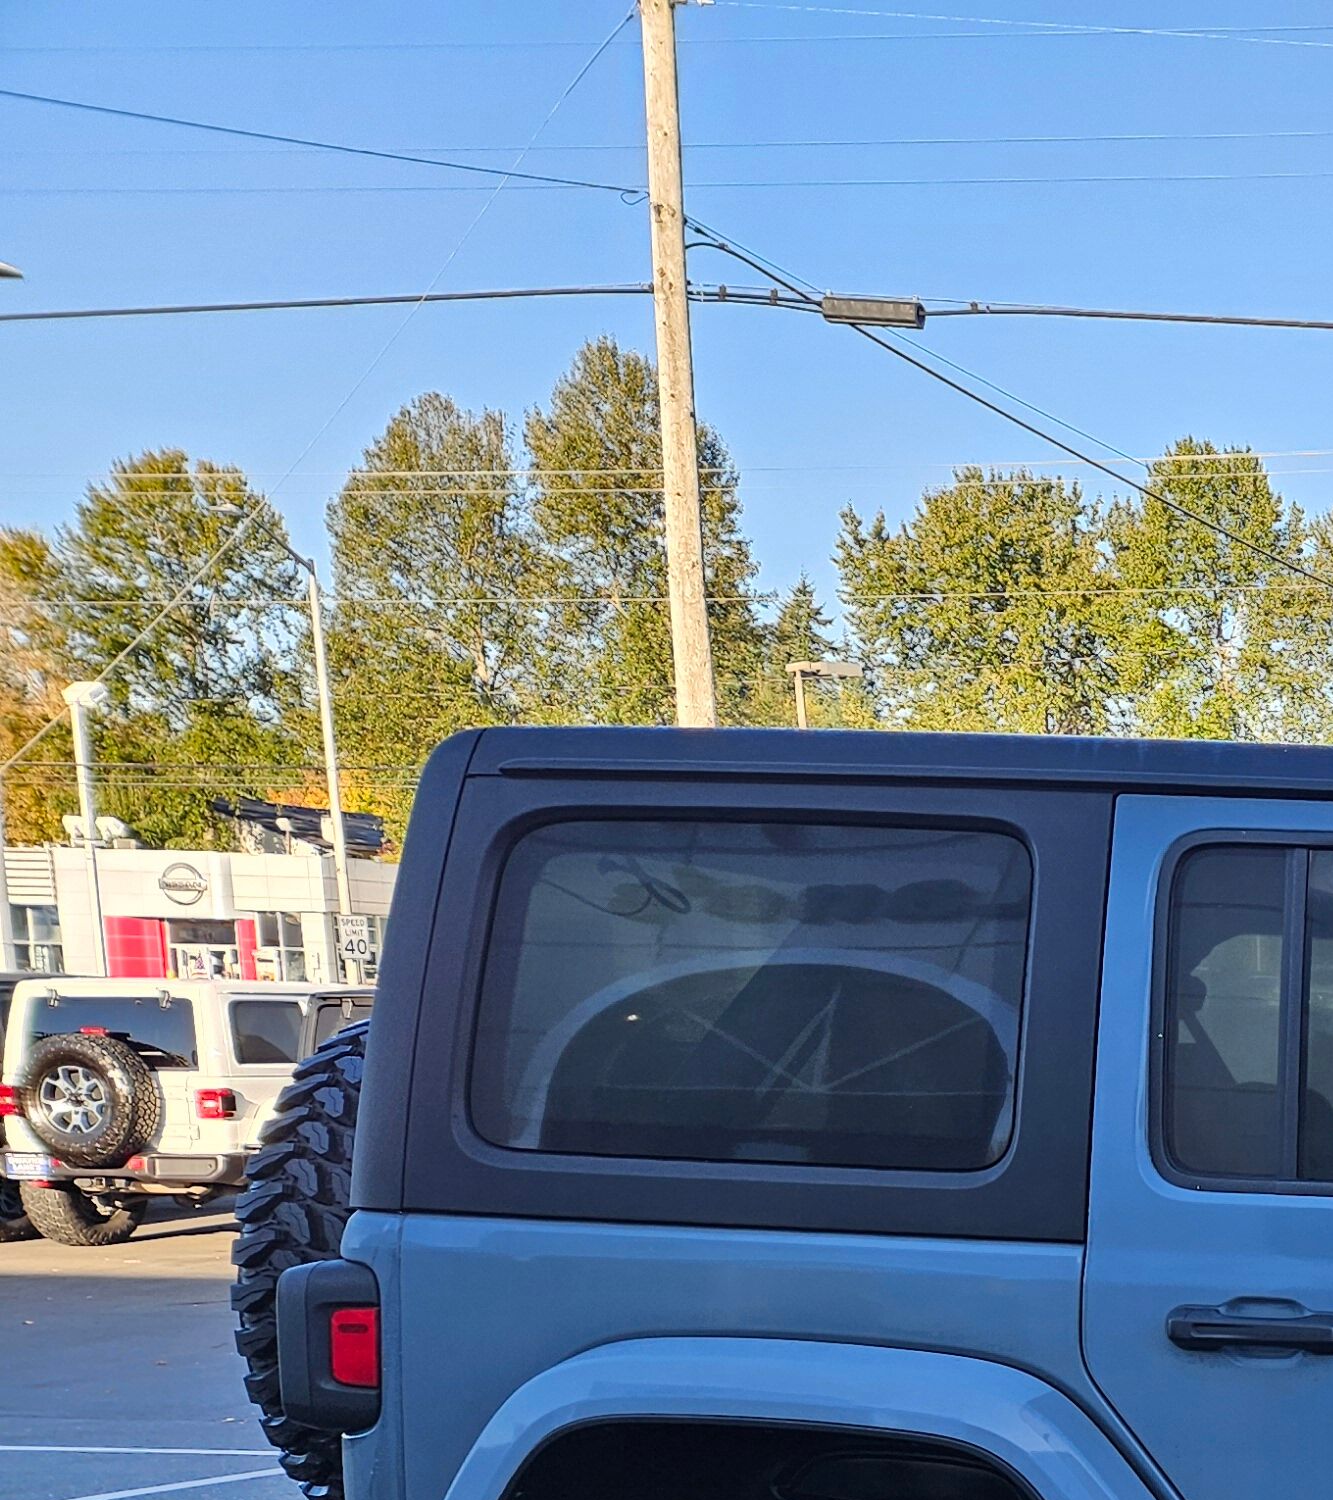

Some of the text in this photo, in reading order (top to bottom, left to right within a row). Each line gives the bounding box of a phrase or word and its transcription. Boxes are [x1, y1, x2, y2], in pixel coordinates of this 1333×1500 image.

[340, 917, 366, 927] SPEED
[344, 929, 364, 937] LIMIT
[344, 939, 368, 955] 40
